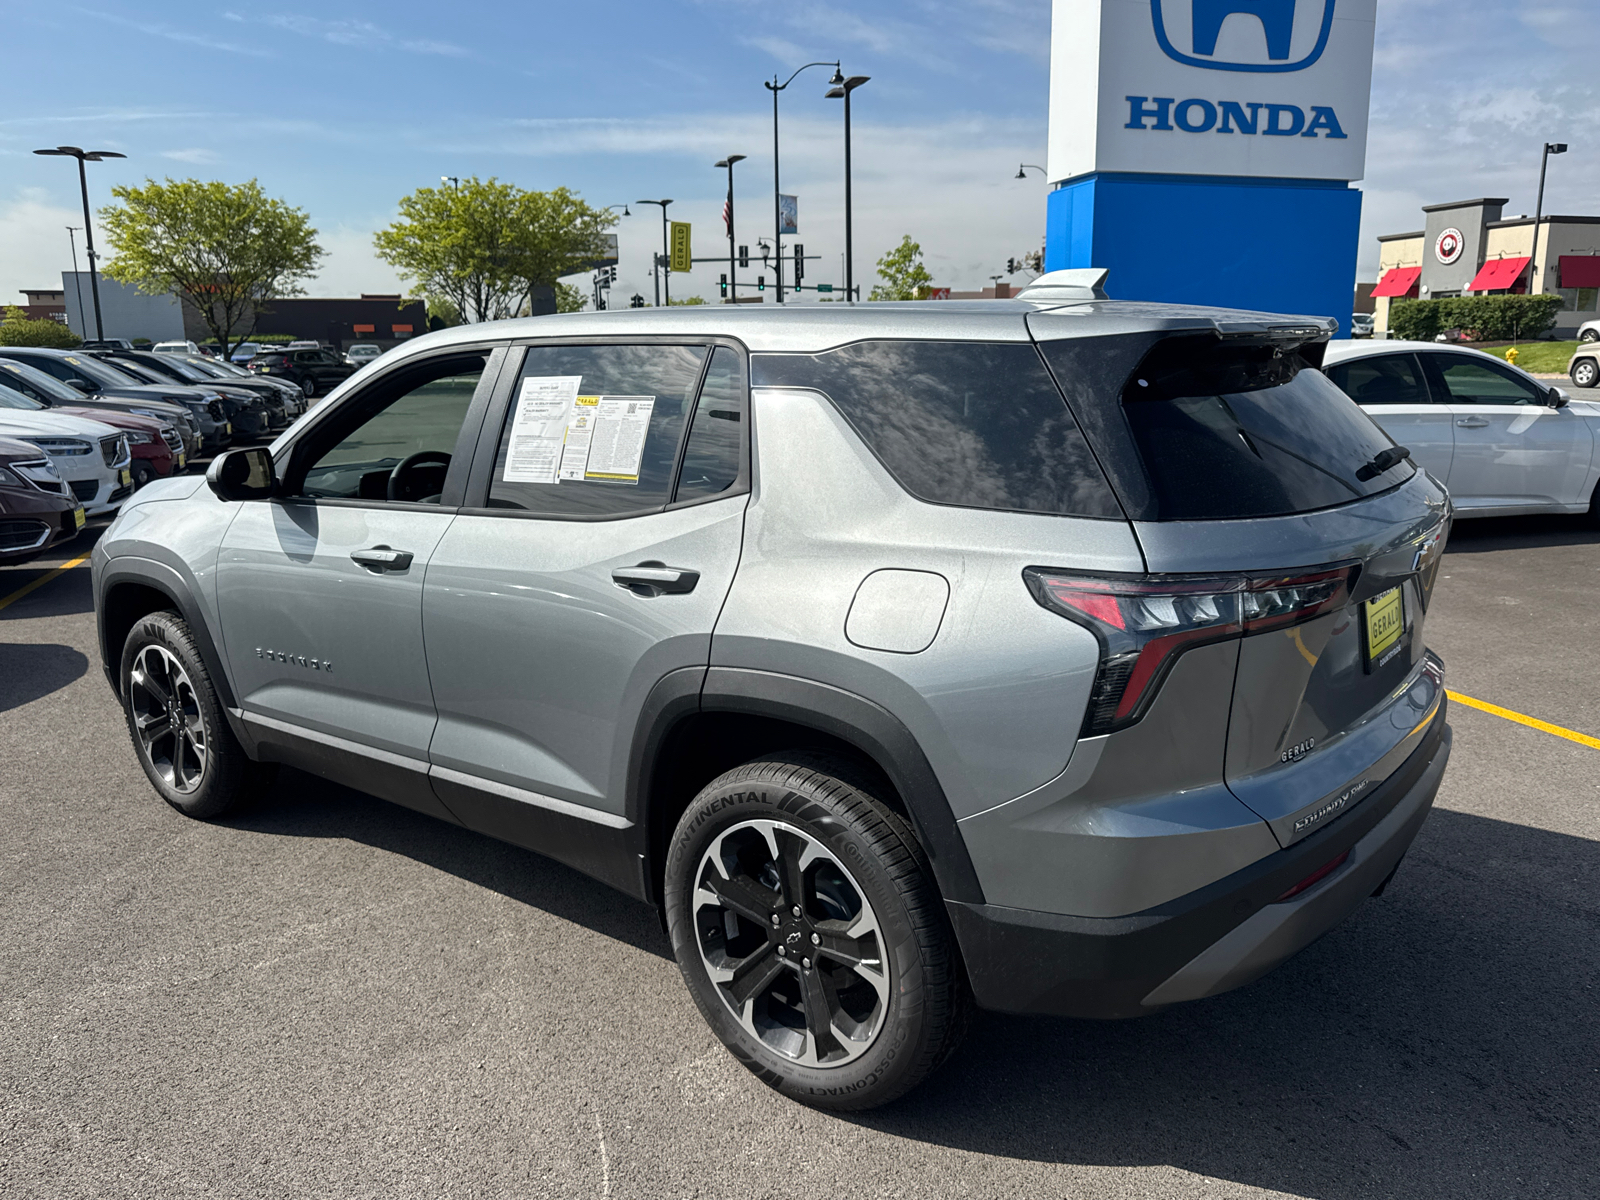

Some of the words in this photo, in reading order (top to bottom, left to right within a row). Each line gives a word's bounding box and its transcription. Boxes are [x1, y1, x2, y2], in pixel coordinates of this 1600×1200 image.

[1124, 96, 1348, 139] HONDA
[677, 228, 685, 266] GERALD
[1373, 606, 1399, 639] GERALD
[256, 647, 333, 673] EQUINOX
[1282, 737, 1315, 762] GERALD
[1295, 792, 1349, 833] EQUINOX
[670, 791, 773, 877] CONTINENTAL
